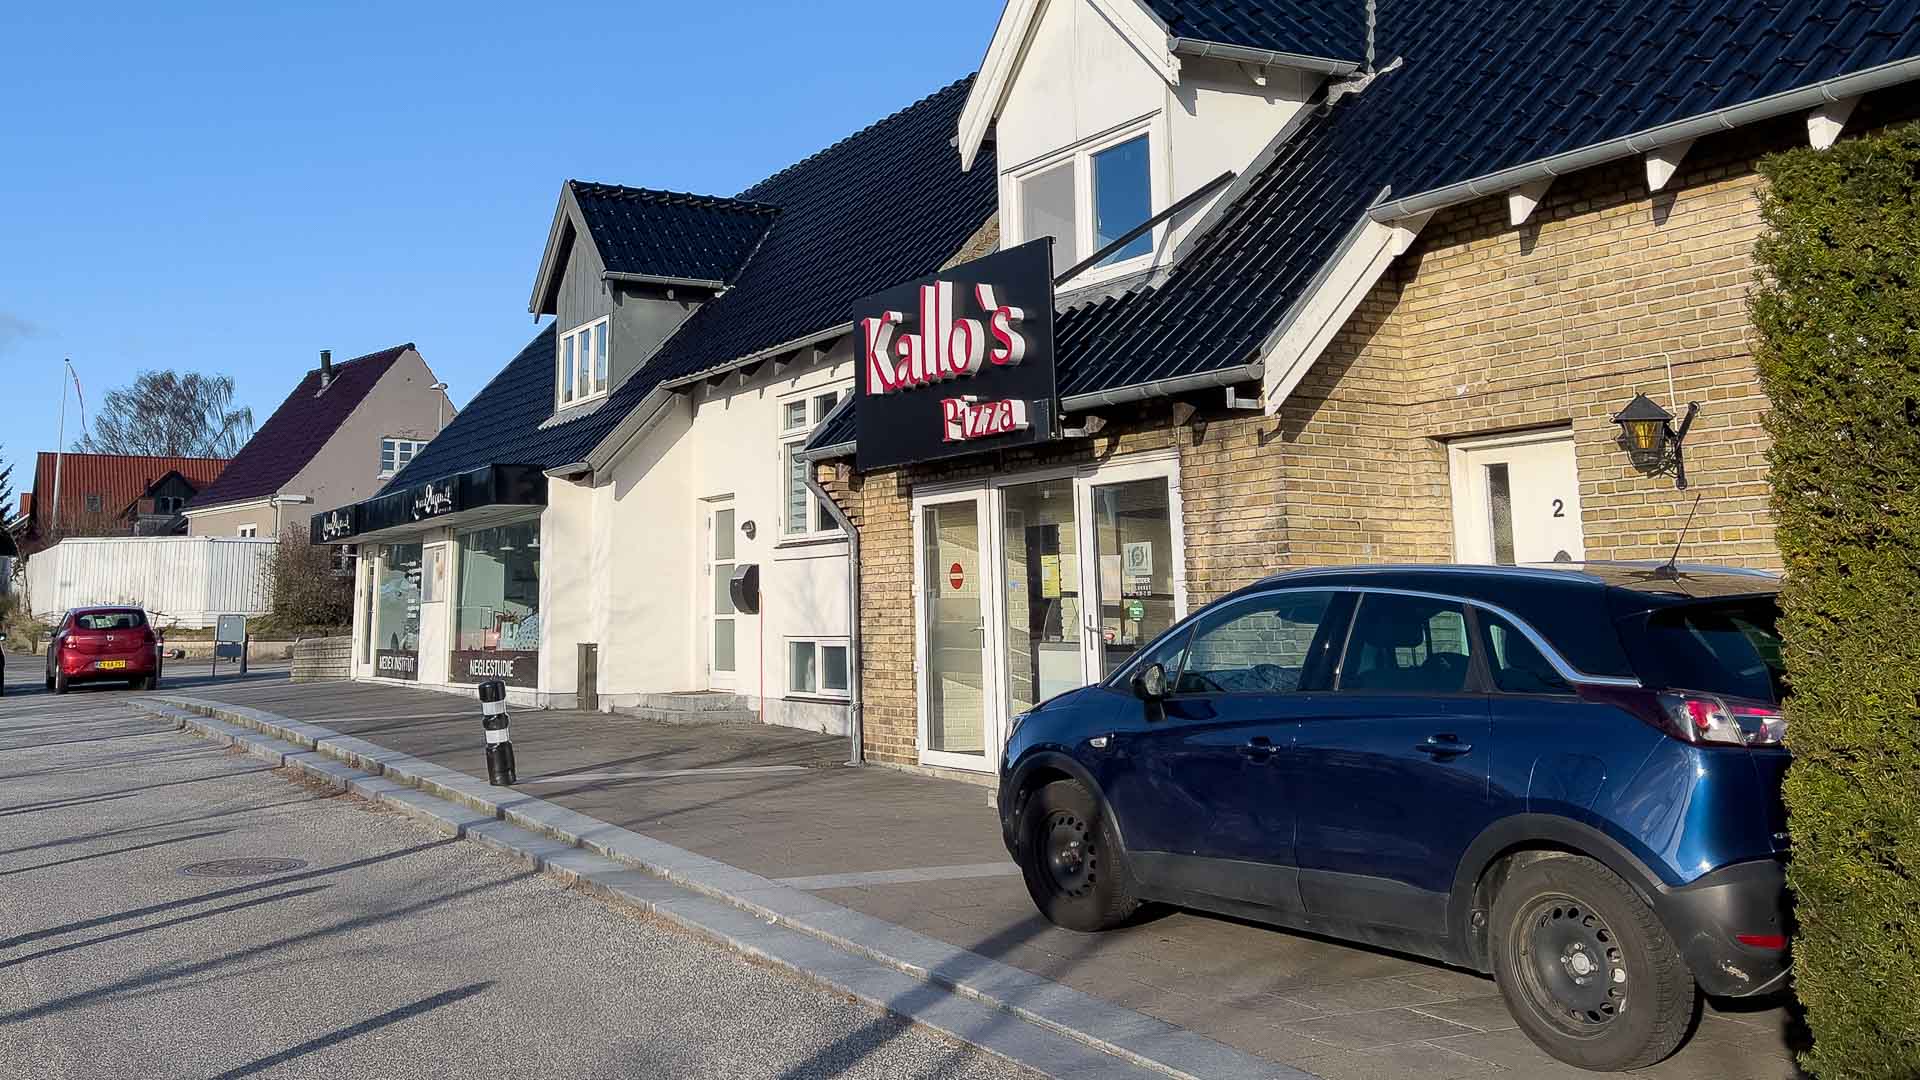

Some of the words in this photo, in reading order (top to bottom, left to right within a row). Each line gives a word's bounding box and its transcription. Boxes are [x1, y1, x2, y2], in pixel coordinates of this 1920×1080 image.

[942, 395, 1028, 442] Pizza
[1552, 499, 1565, 517] 2
[470, 659, 514, 677] NEGLESTUDIE
